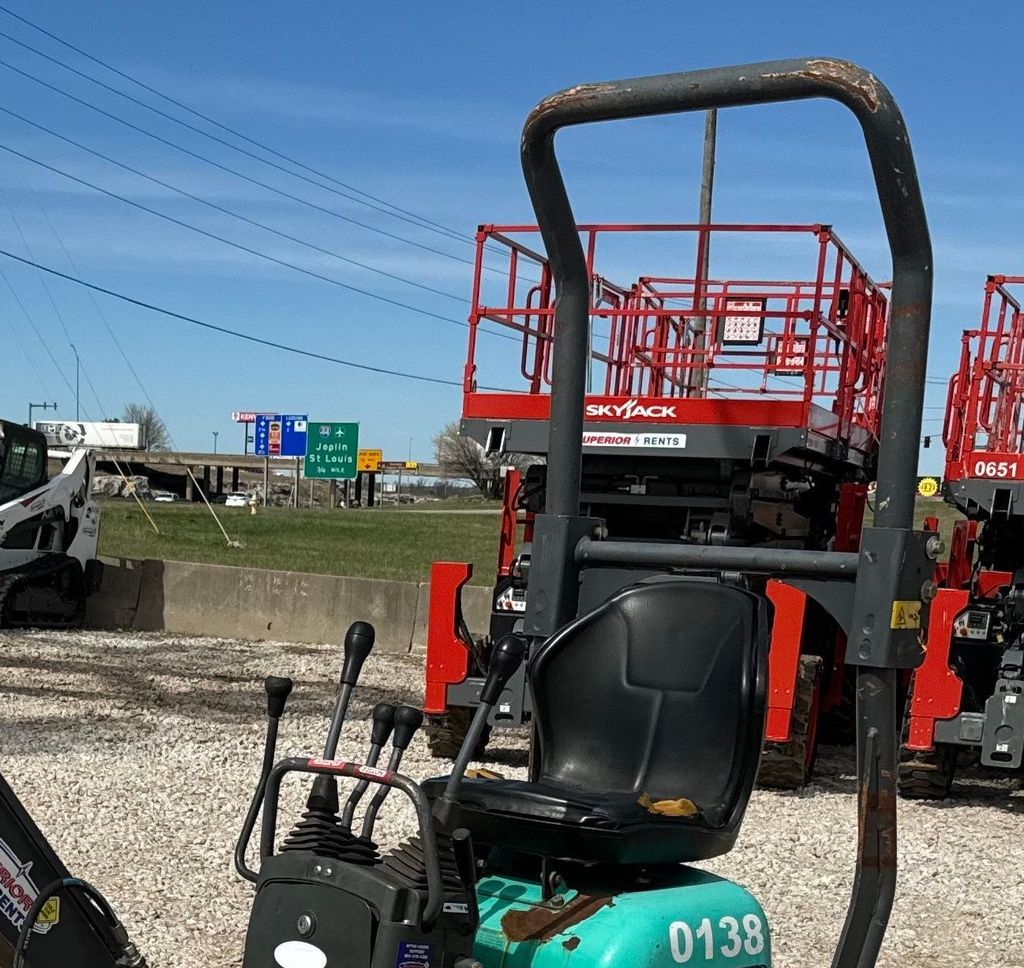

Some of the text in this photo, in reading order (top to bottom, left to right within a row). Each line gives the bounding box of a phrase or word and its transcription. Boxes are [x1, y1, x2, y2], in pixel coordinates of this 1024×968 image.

[586, 399, 677, 420] SKYJACK
[316, 442, 348, 452] Joplin
[583, 435, 680, 446] UPERIOR RENTS
[309, 454, 322, 463] St
[325, 454, 353, 463] Louis
[975, 461, 1018, 478] 0651
[669, 913, 765, 963] 0138
